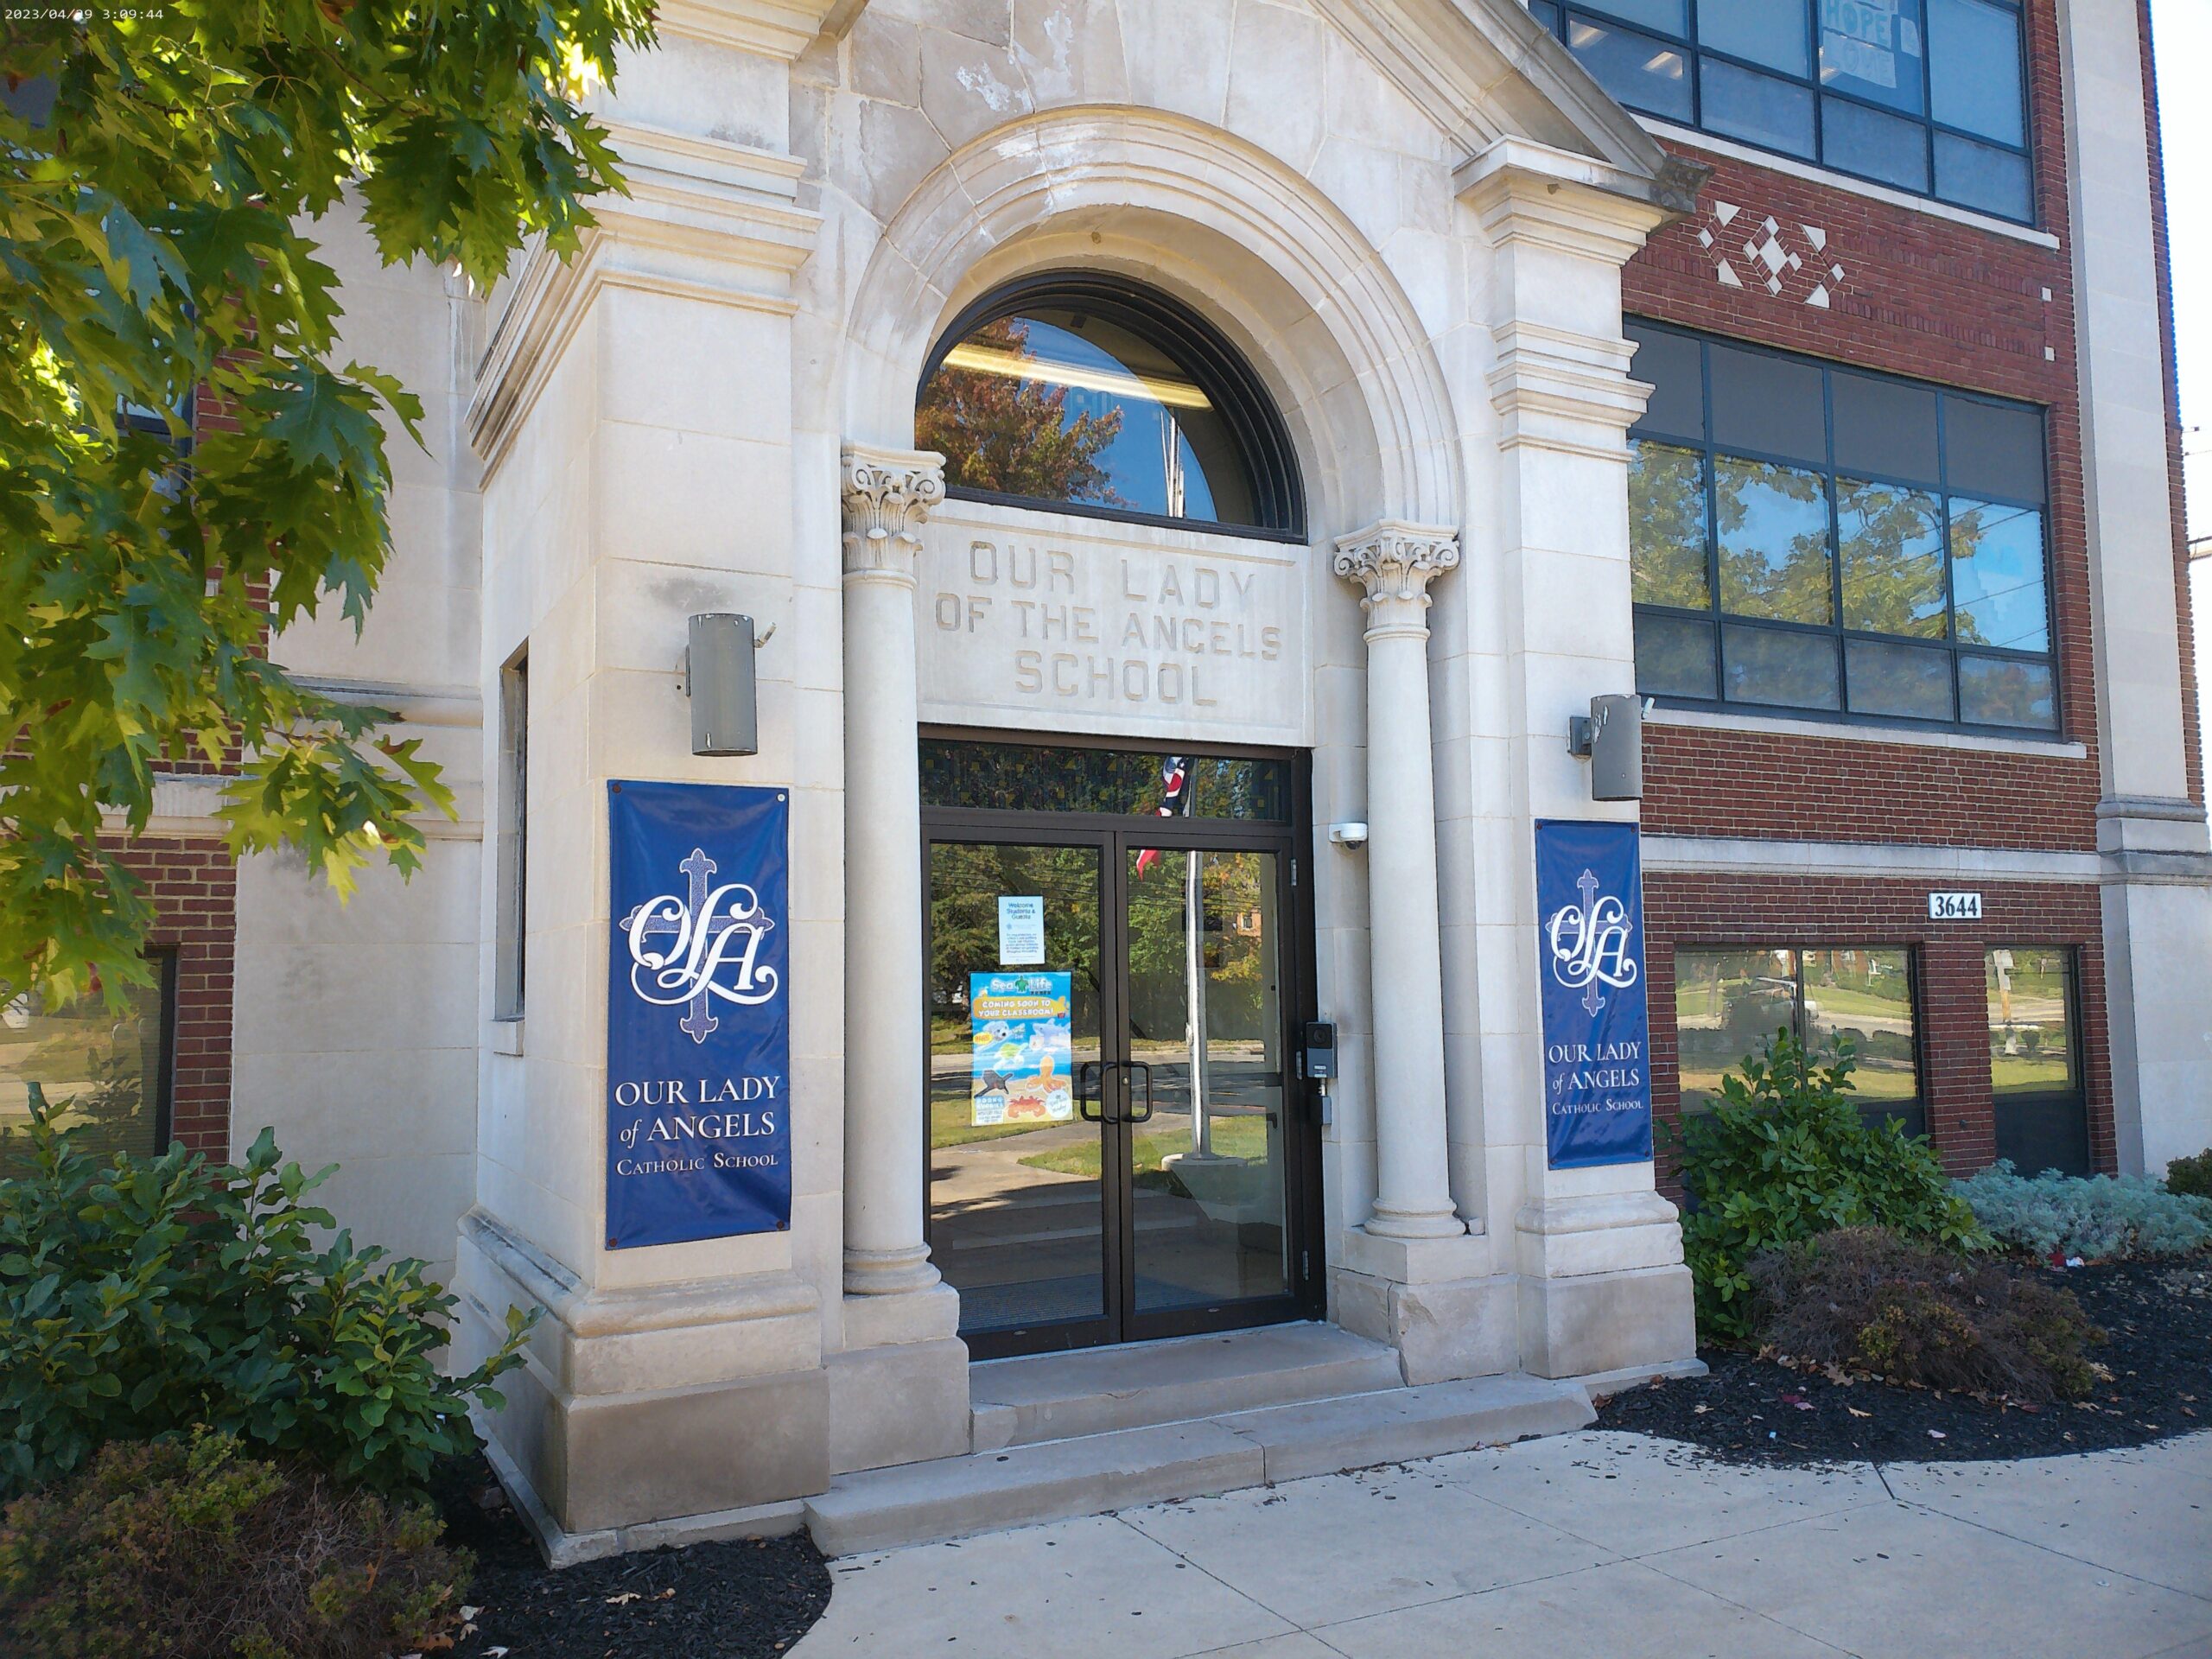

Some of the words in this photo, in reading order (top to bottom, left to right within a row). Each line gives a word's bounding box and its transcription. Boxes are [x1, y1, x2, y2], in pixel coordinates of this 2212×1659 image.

[1826, 0, 1888, 46] HOPE
[969, 540, 1074, 594] OUR
[1122, 559, 1255, 609] LADY
[935, 592, 992, 633] OF
[1011, 599, 1099, 644] THE
[1014, 649, 1218, 707] SCHOOL
[1936, 895, 1977, 917] 3644
[992, 978, 1014, 991] Sea
[1030, 977, 1052, 990] Life
[1002, 1007, 1053, 1016] CLASSROOM!
[1548, 1044, 1592, 1064] OUR
[1597, 1041, 1642, 1061] LADY
[614, 1079, 690, 1107] OUR
[698, 1075, 781, 1103] LADY
[1553, 1072, 1565, 1095] of
[1567, 1068, 1639, 1090] ANGELS
[1553, 1102, 1602, 1115] CATHOLIC
[1605, 1098, 1643, 1111] SCHOOL
[620, 1118, 642, 1148] of
[647, 1111, 775, 1141] ANGELS
[616, 1158, 704, 1176] CATHOLIC
[714, 1152, 779, 1168] SCHOOL
